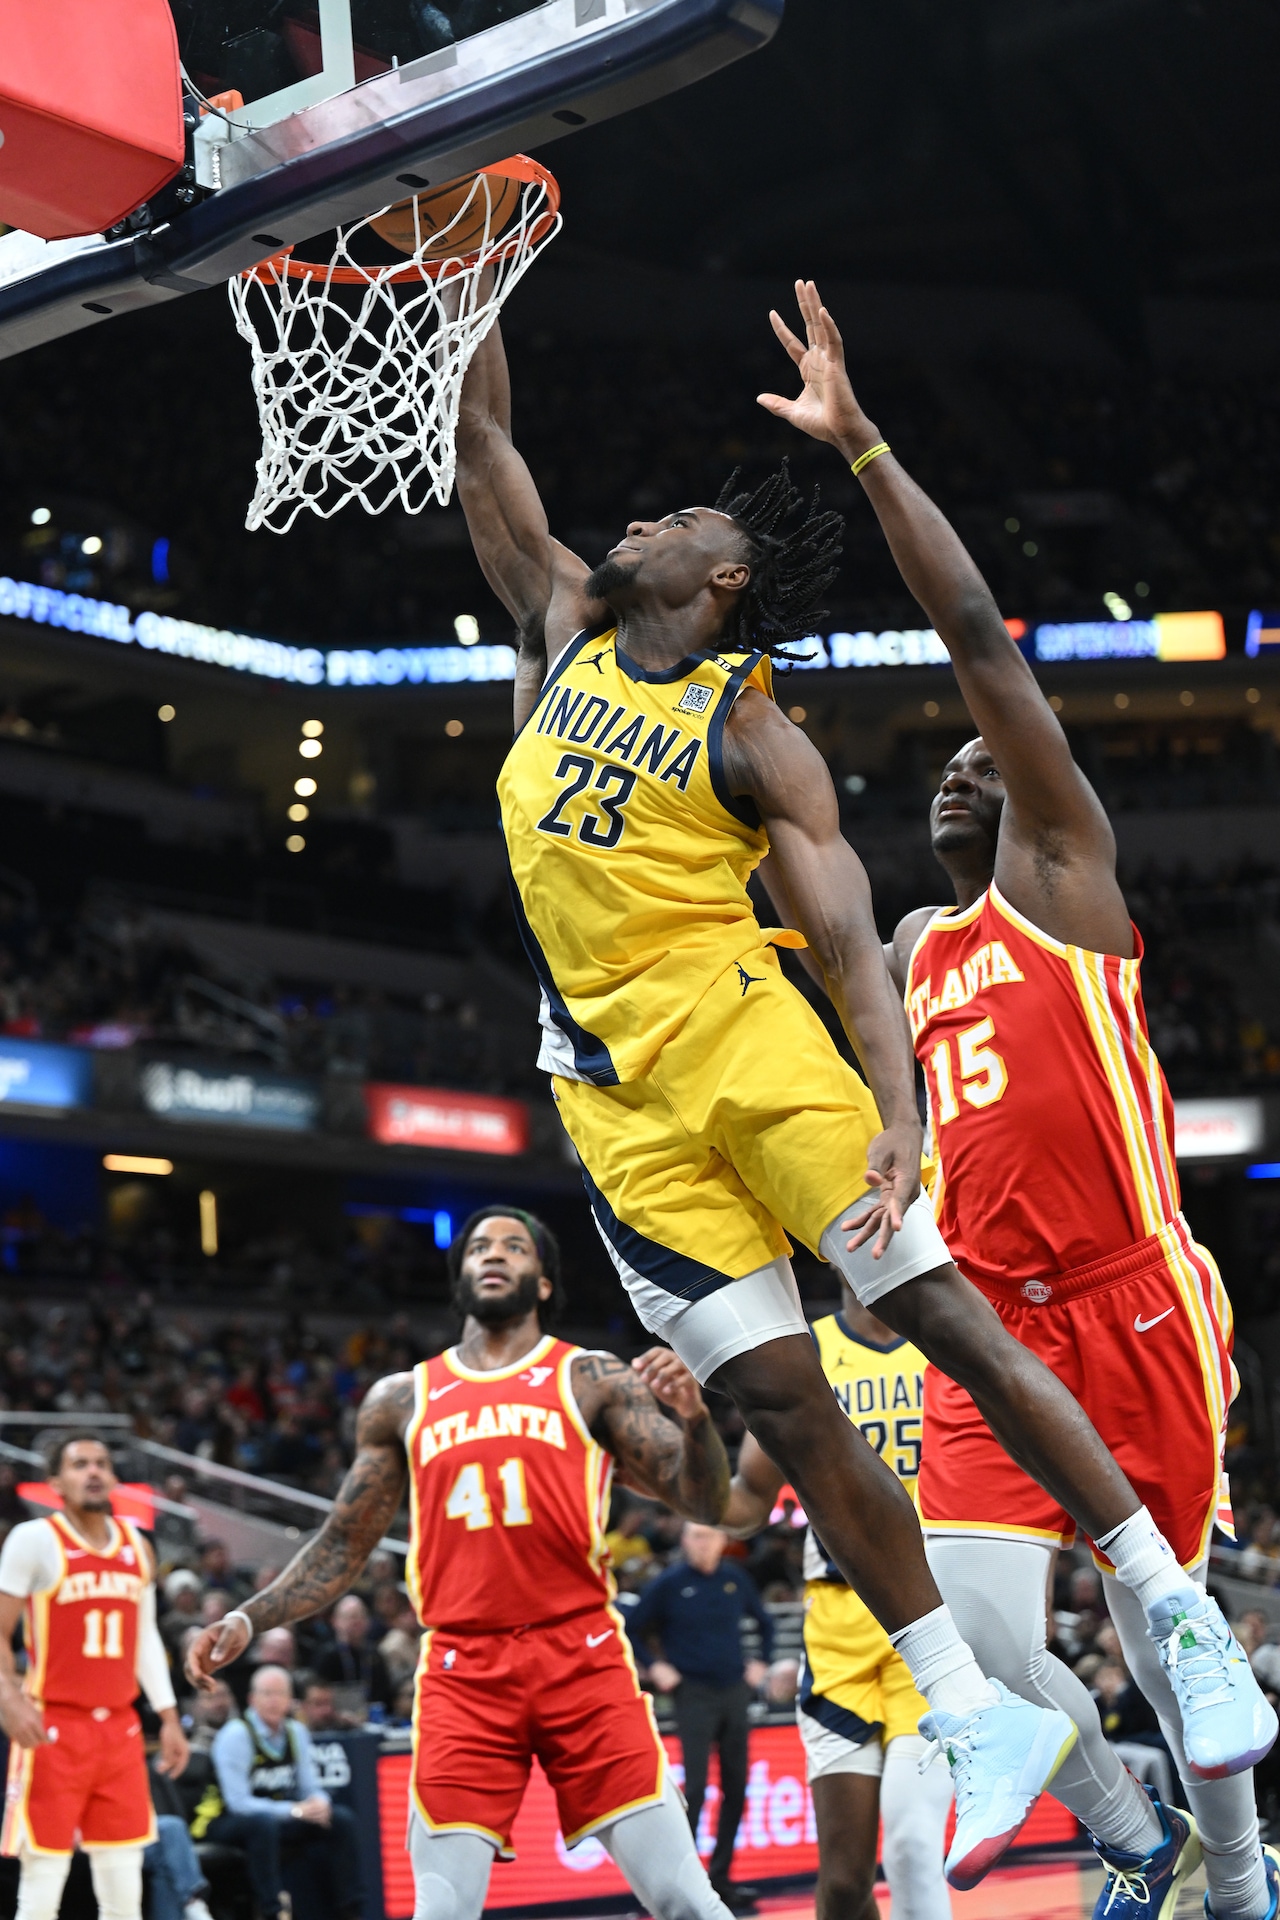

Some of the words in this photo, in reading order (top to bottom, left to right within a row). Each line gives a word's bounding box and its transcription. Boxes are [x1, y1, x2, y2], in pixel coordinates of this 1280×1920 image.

[537, 685, 702, 793] INDIANA
[671, 706, 705, 720] spokenote
[534, 754, 639, 850] 23
[930, 1015, 1009, 1126] 15
[1020, 1285, 1054, 1298] HAWKS
[833, 1372, 924, 1416] NDIAN
[420, 1404, 567, 1468] ATLANTA
[446, 1456, 533, 1531] 41
[56, 1570, 141, 1606] ATLANT
[82, 1608, 124, 1659] 11
